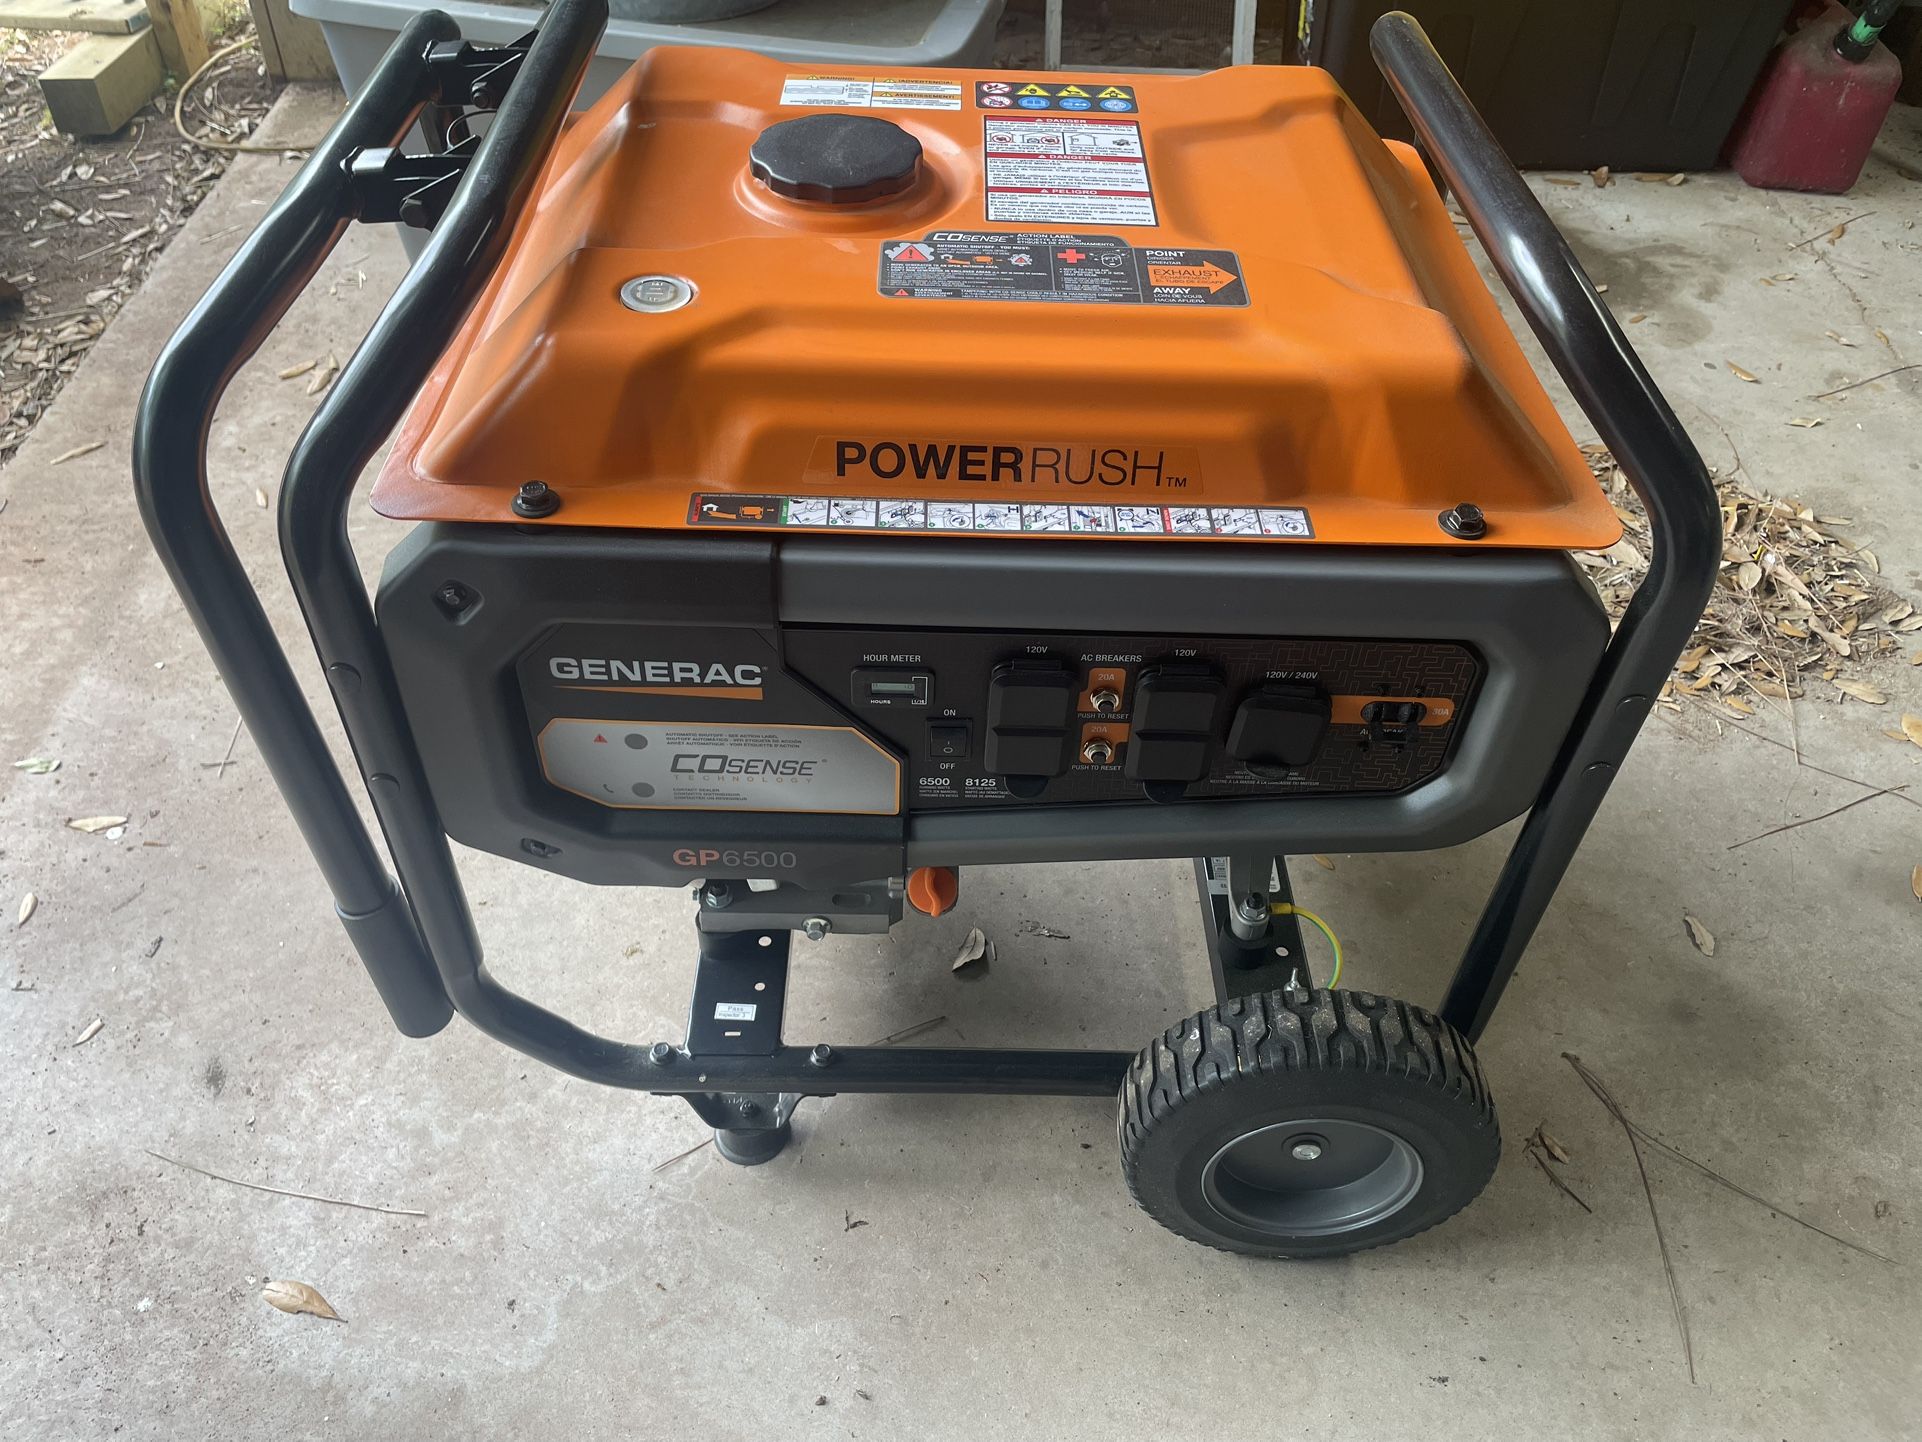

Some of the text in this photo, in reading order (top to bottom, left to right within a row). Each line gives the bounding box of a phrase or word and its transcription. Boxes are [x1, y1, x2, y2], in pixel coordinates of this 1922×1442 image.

[836, 441, 1164, 486] POWERRUSH
[549, 657, 762, 685] GENERAC
[674, 775, 812, 784] TECHNOLOGY
[919, 777, 996, 786] 6500 8125
[673, 848, 797, 868] GP6500
